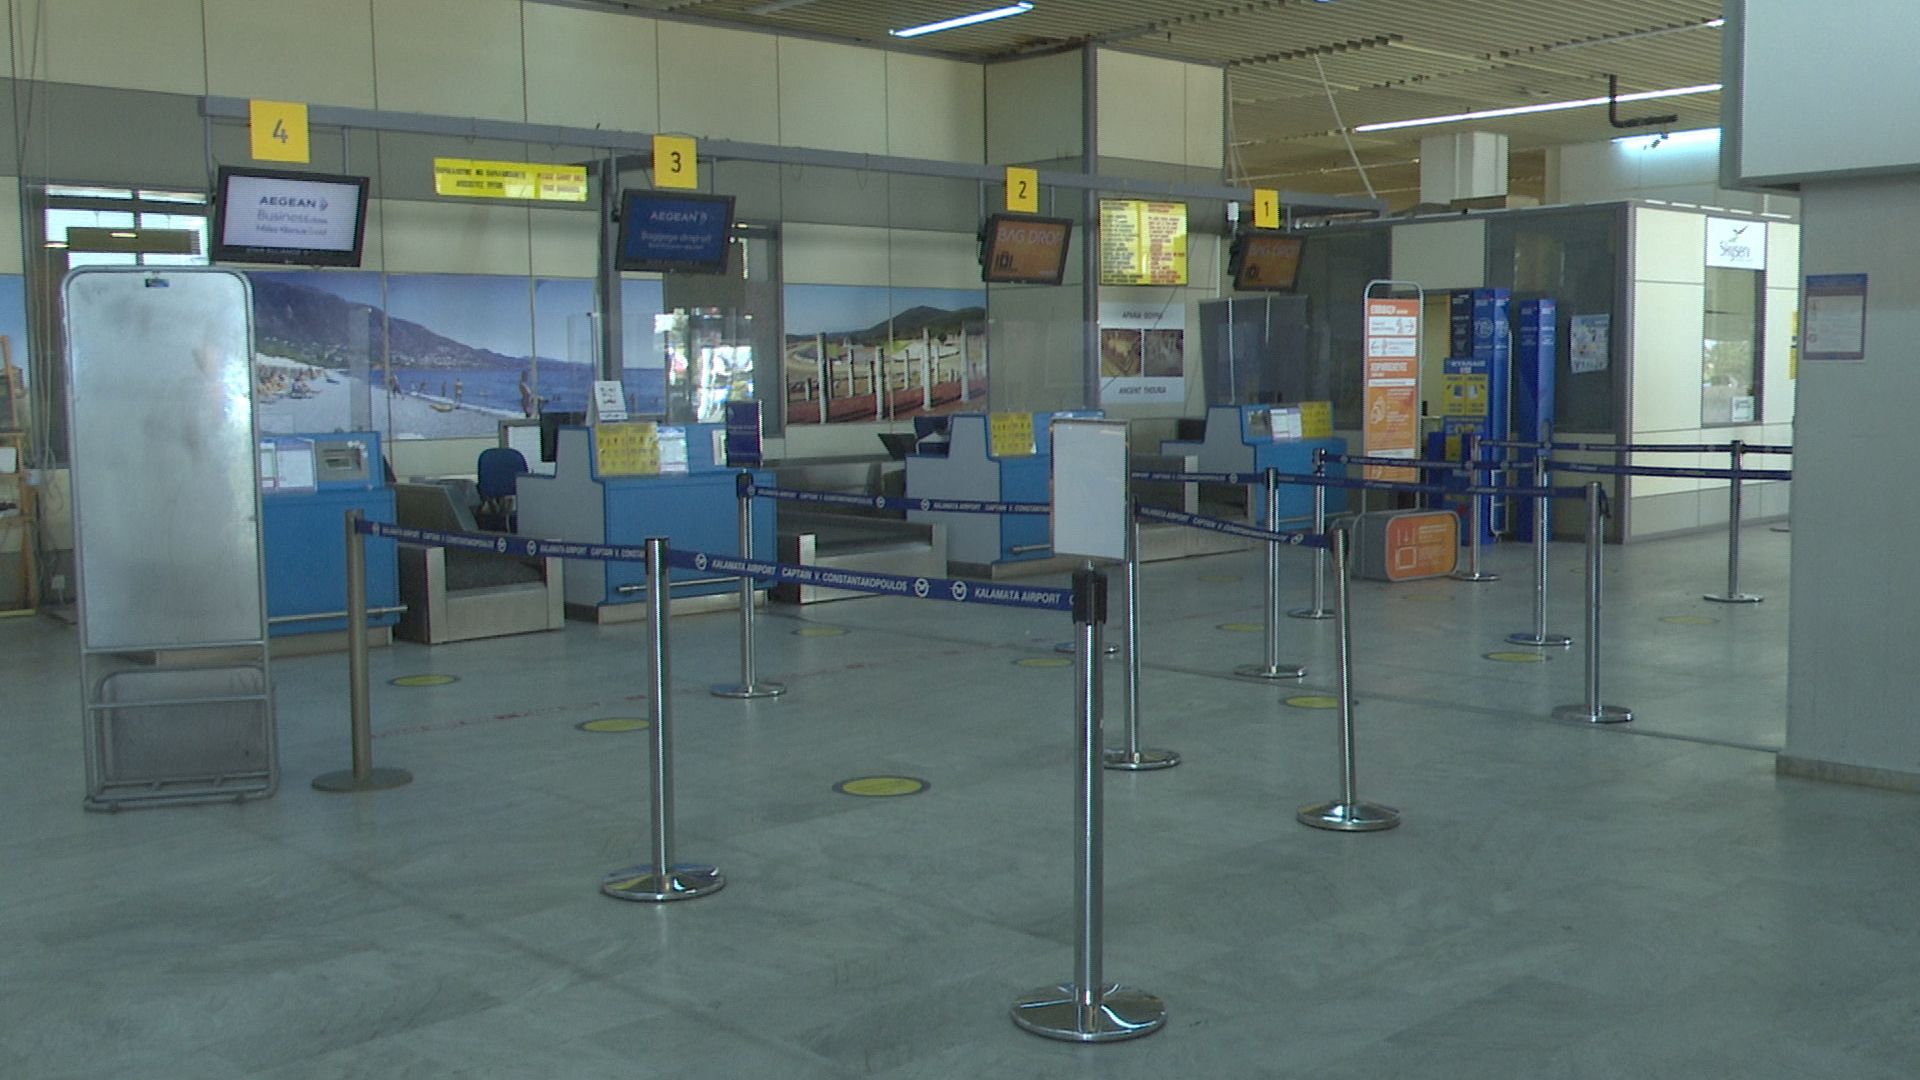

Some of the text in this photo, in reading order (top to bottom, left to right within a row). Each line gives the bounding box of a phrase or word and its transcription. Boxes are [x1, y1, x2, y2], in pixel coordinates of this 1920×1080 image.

[272, 119, 289, 144] 4
[671, 150, 682, 174] 3
[1018, 180, 1027, 200] 2
[259, 196, 317, 209] AEGEAN
[1264, 201, 1270, 218] 1
[649, 211, 697, 223] AEGEAN
[996, 228, 1025, 243] BAG
[712, 559, 745, 572] KALAMATA
[746, 563, 776, 576] AIRPORT
[781, 567, 811, 581] CAPTAIN
[823, 572, 908, 593] CONSTANTAKOPOULOS
[974, 587, 1019, 602] KALAMATA
[1021, 590, 1062, 605] AIRPORT
